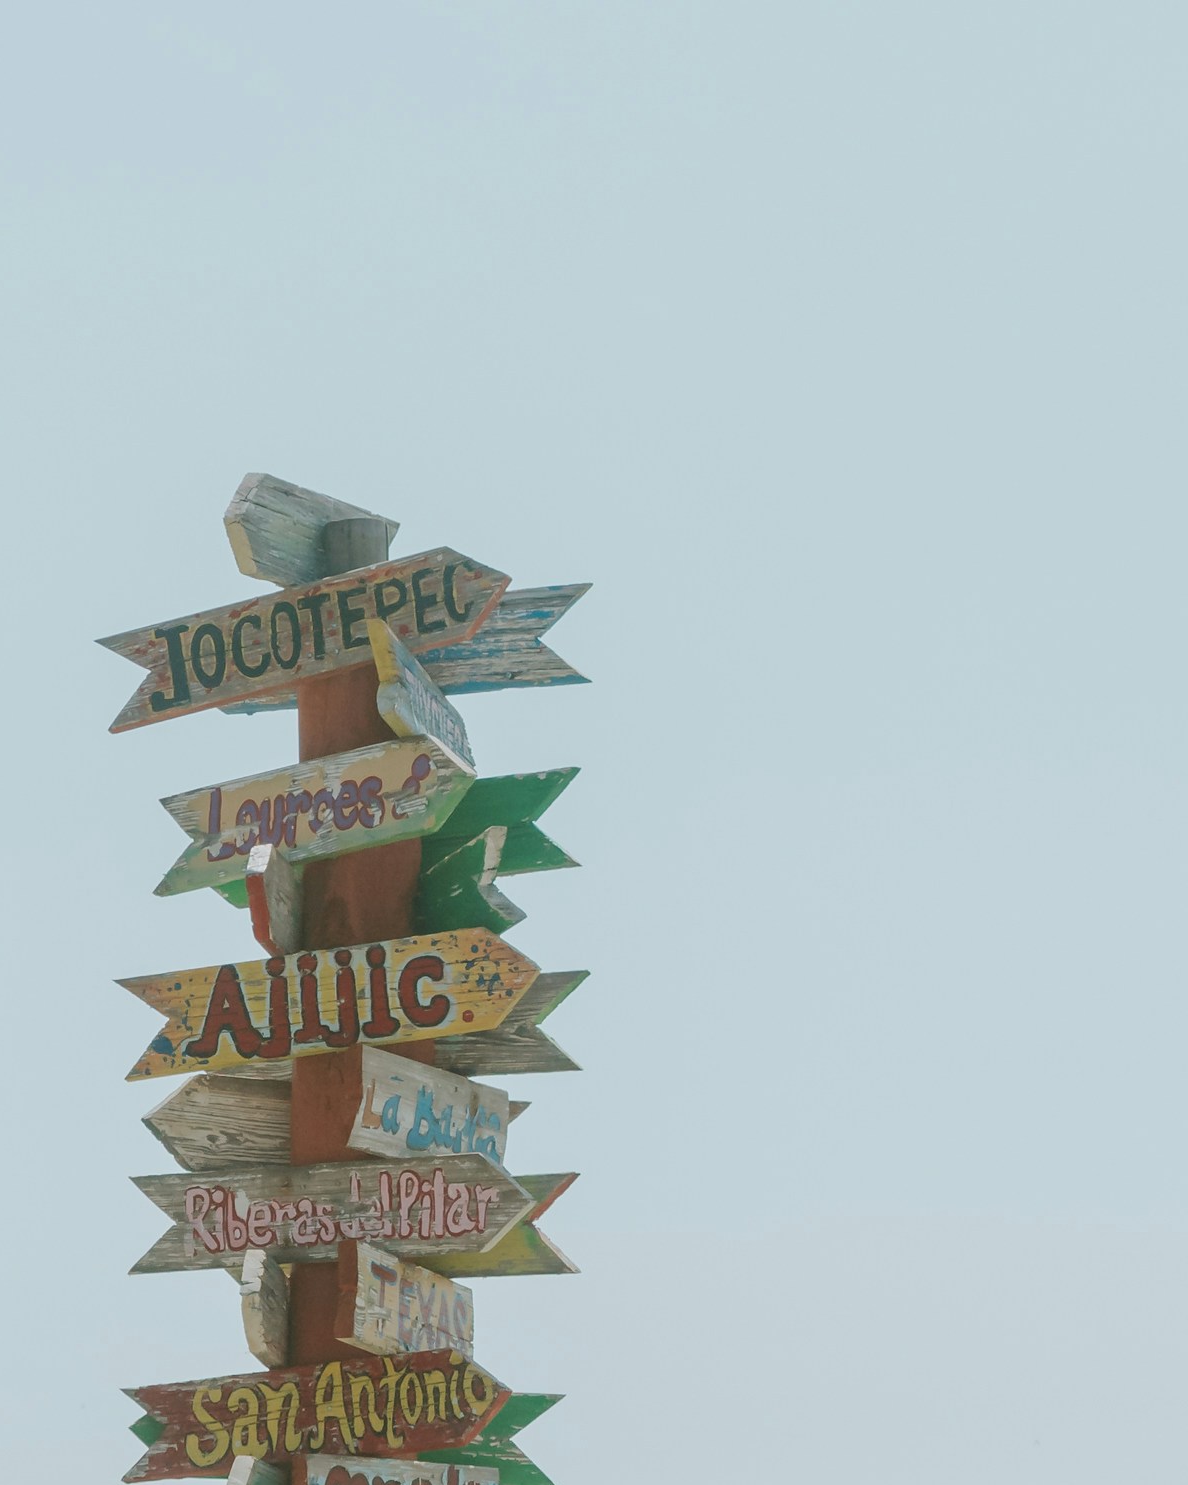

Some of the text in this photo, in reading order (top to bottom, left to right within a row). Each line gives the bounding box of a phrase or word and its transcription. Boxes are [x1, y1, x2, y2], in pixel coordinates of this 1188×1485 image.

[150, 563, 477, 712] JOCOTEPEC
[185, 943, 451, 1059] Ajijic
[362, 1078, 401, 1136] La
[184, 1184, 337, 1253] Riberas
[397, 1167, 499, 1240] Pilar
[185, 1350, 494, 1467] San Antonio
